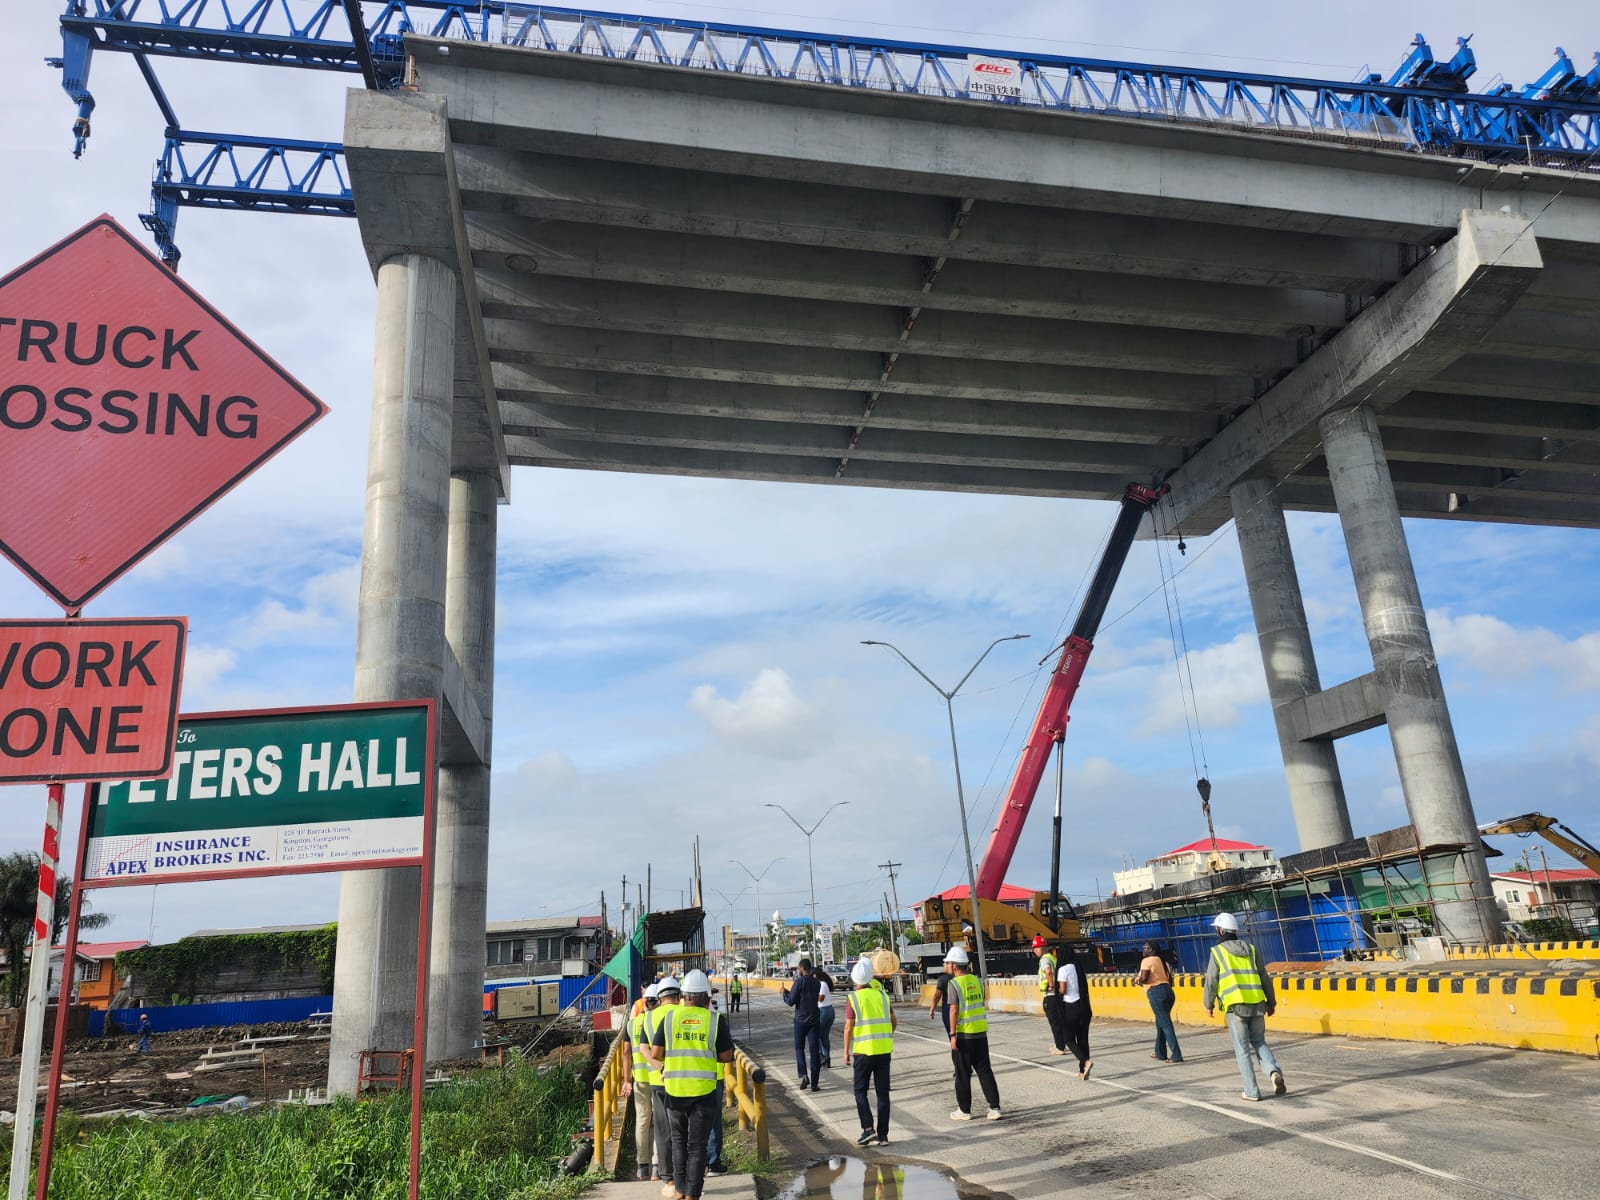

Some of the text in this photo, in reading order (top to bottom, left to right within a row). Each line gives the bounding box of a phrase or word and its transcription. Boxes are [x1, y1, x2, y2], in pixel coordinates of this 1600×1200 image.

[971, 82, 1022, 96] 中国铁建
[177, 729, 198, 743] To
[298, 737, 420, 792] HALL
[155, 836, 251, 853] INSURANCE
[106, 849, 271, 876] APEX BROKERS INC.
